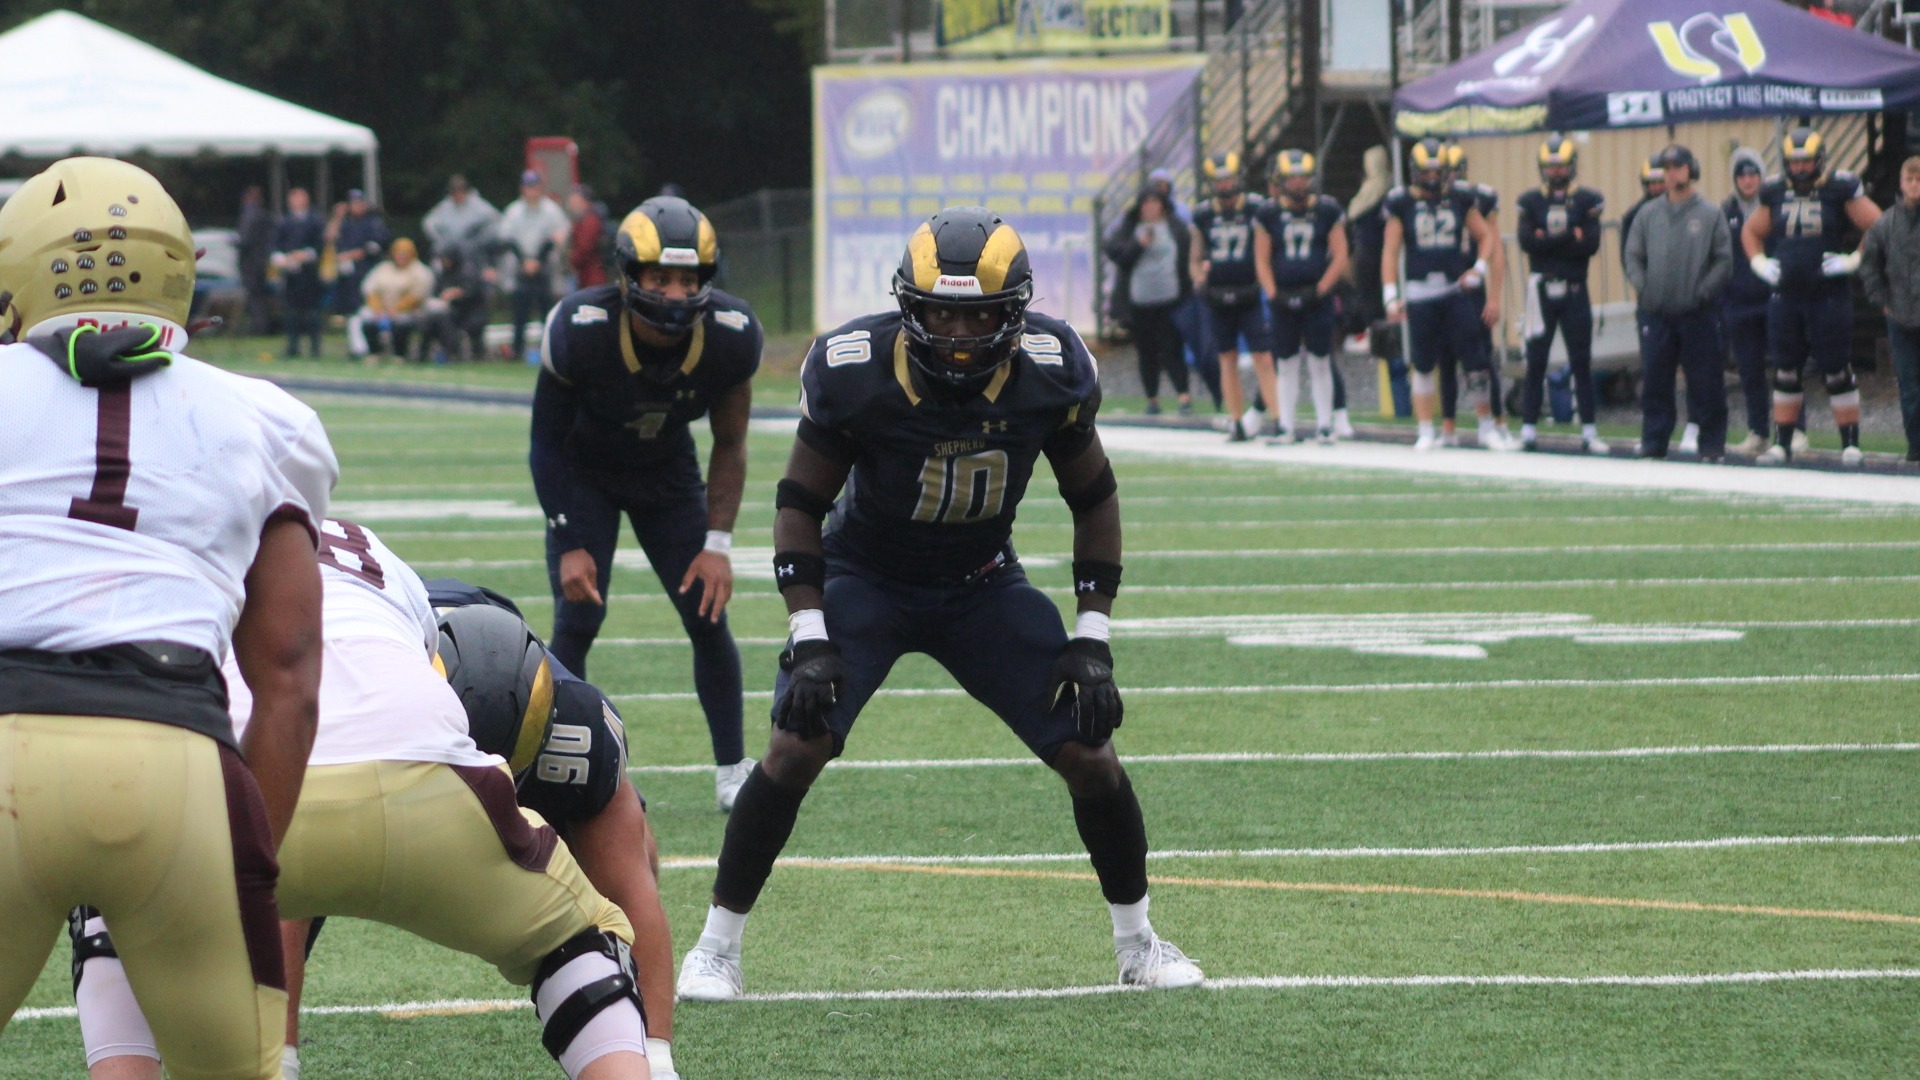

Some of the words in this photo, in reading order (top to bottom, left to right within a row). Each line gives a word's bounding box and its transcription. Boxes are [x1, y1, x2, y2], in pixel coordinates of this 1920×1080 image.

[1667, 85, 1733, 113] PROTECT
[1736, 84, 1762, 107] THIS
[937, 82, 1148, 157] CHAMPIONS
[1781, 201, 1822, 237] 75
[1209, 224, 1249, 260] 37
[940, 278, 975, 287] Riddell
[571, 304, 609, 325] 4
[714, 309, 750, 332] 4
[826, 330, 871, 367] 10
[1020, 333, 1063, 366] 10
[67, 376, 139, 531] 1
[934, 439, 986, 457] SHEPHERD
[911, 449, 1009, 523] 10
[536, 723, 592, 785] 90
